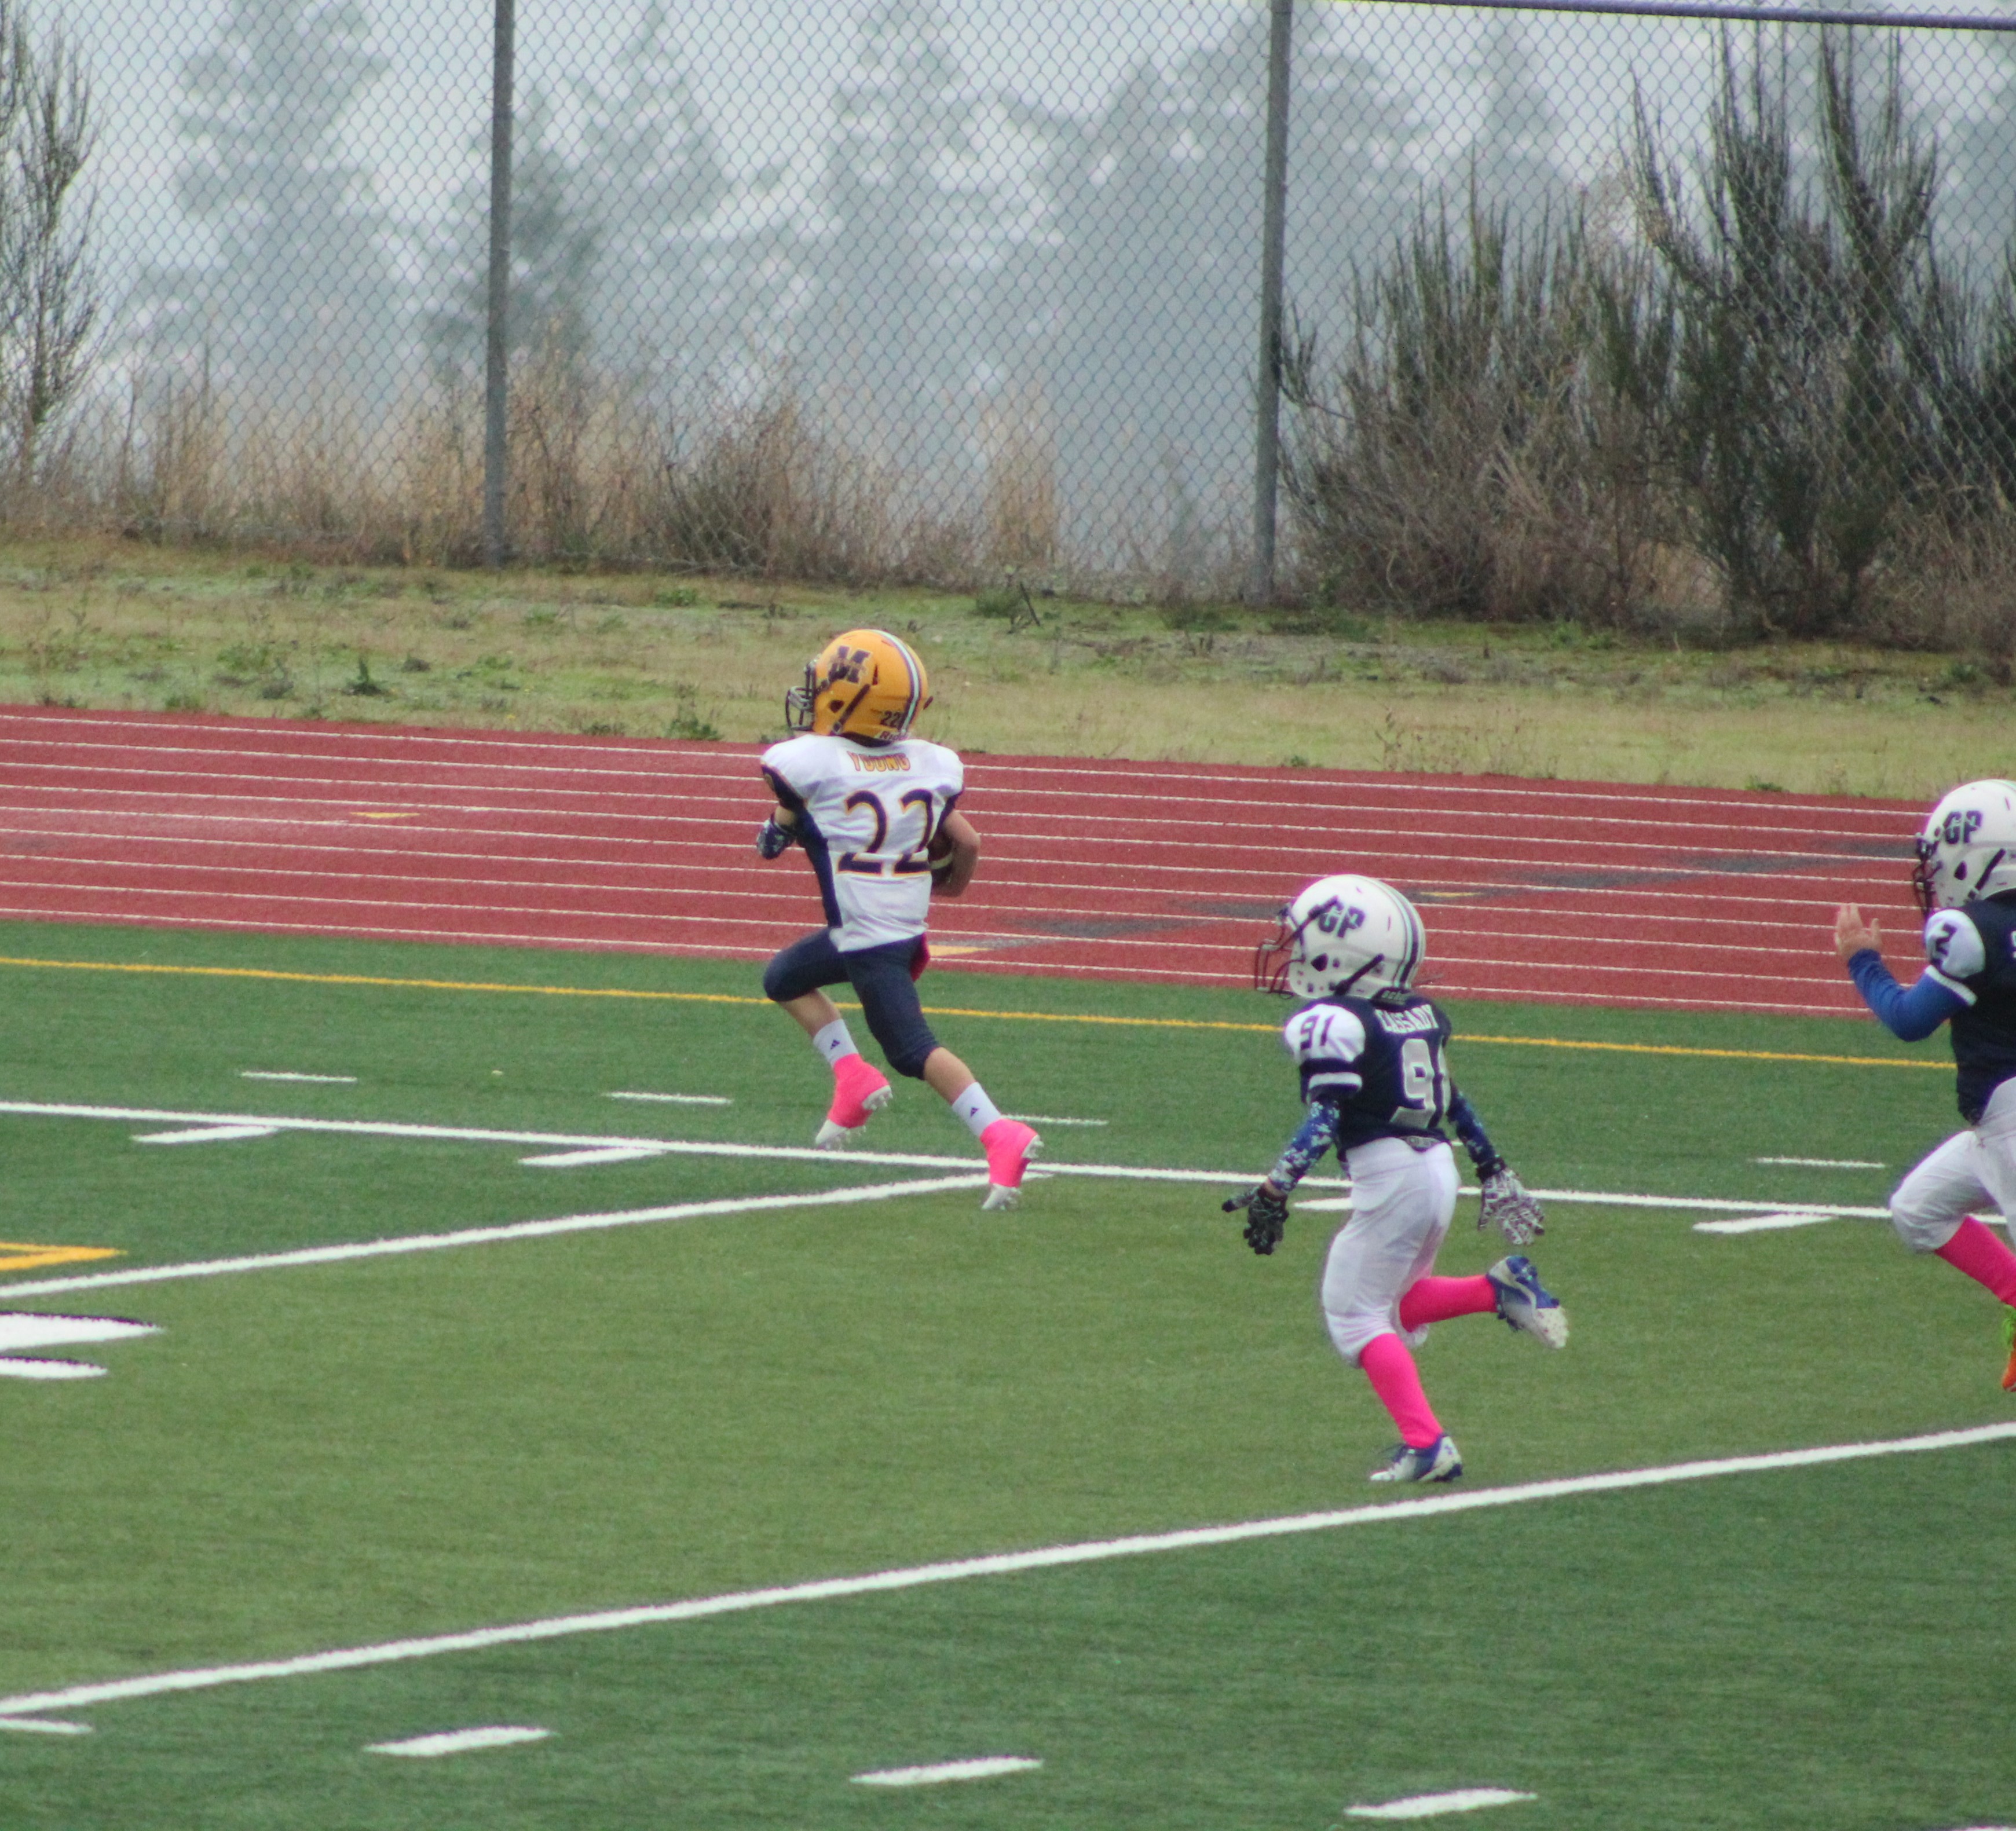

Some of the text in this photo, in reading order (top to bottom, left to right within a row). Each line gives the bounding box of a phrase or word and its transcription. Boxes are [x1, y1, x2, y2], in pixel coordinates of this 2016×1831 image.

[880, 711, 901, 728] 22
[836, 789, 931, 877] 22
[1944, 810, 1982, 844] GP
[1300, 1014, 1335, 1050] 91
